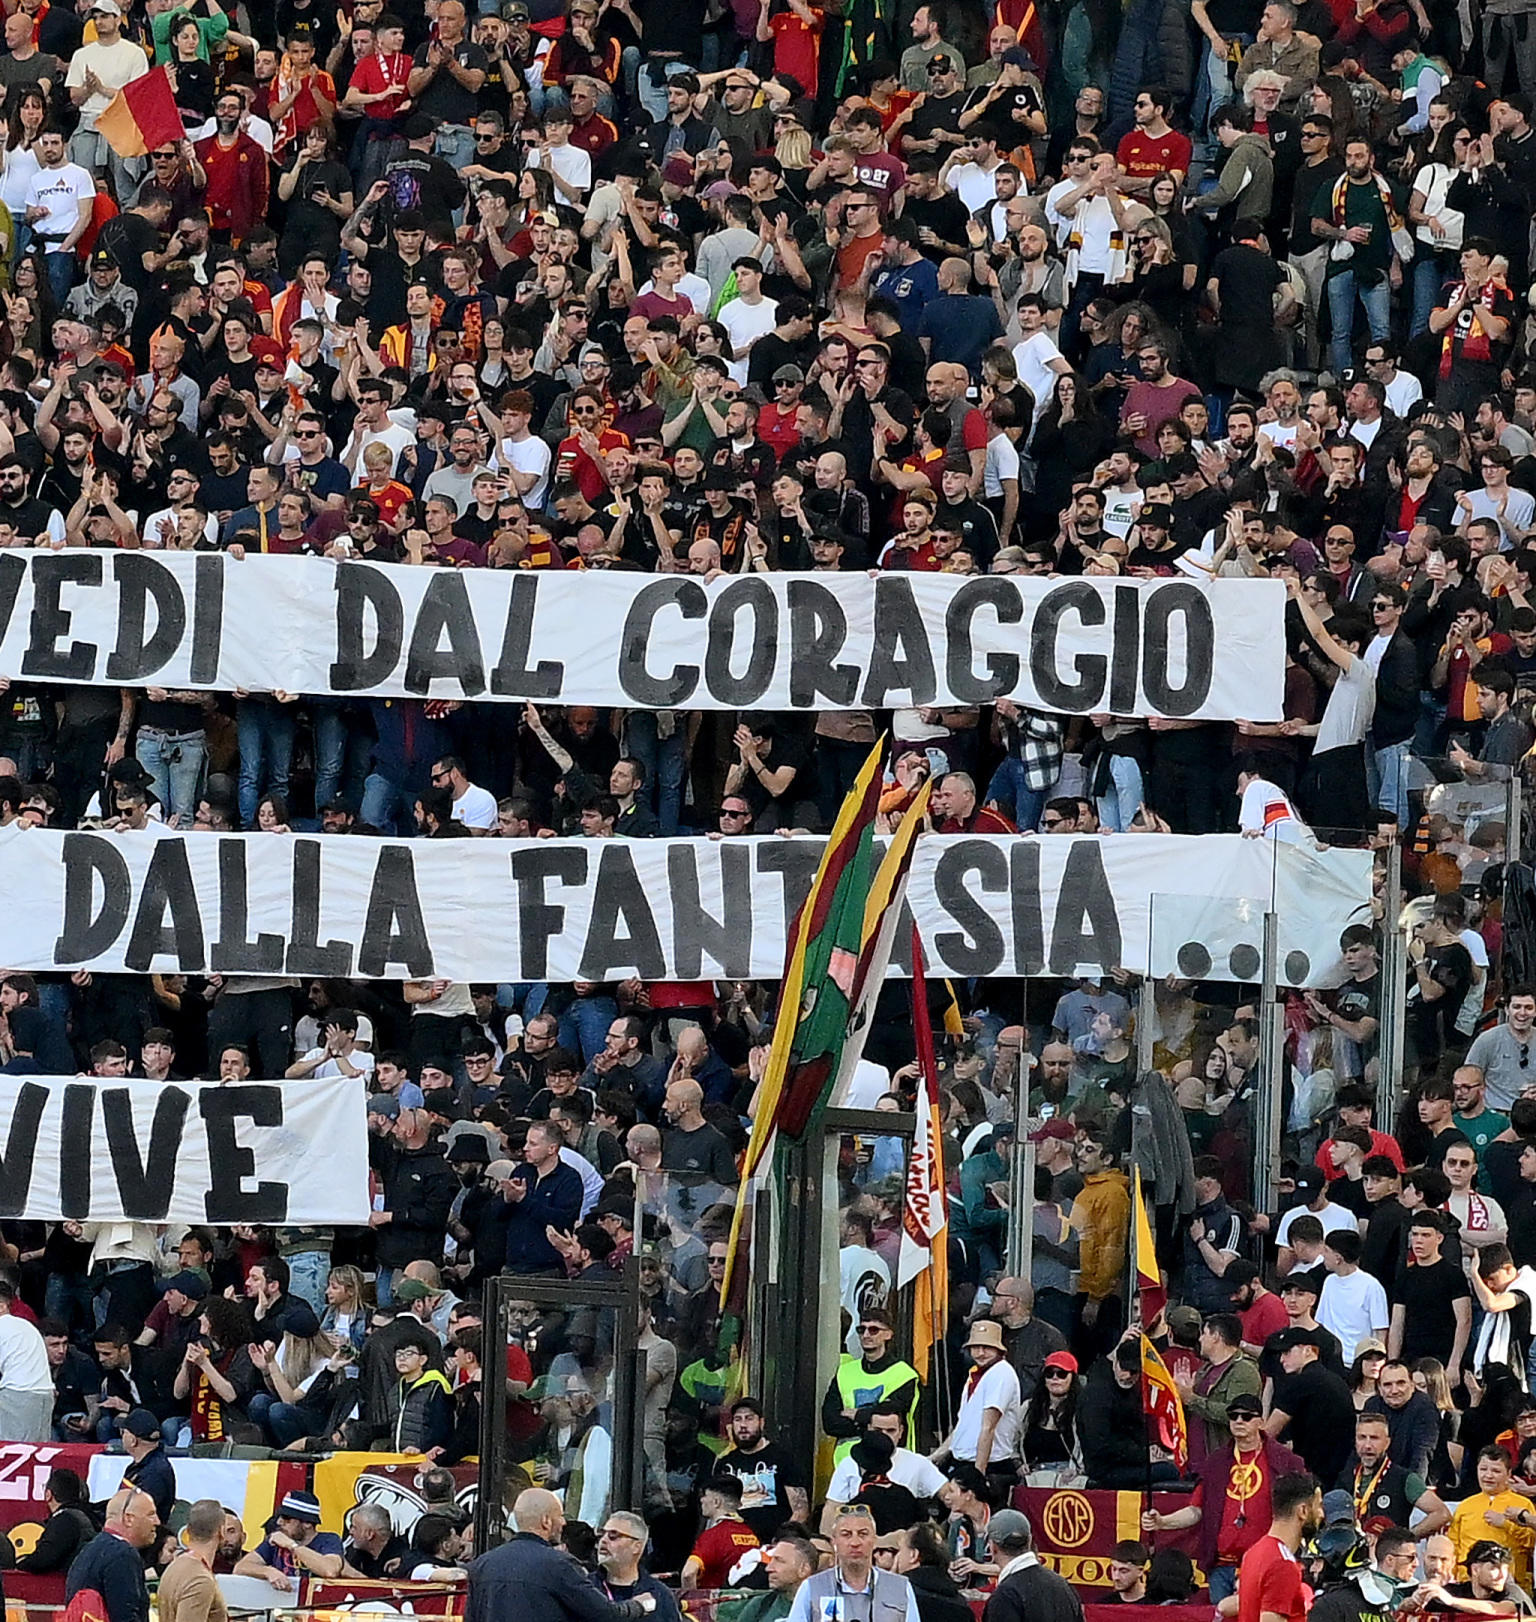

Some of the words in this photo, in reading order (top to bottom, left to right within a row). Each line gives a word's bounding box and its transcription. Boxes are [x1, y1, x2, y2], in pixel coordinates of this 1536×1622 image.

[330, 561, 564, 698] DAL
[619, 577, 1214, 716] CORAGGIO
[54, 833, 433, 977] DALLA
[1047, 1496, 1090, 1543] ASR
